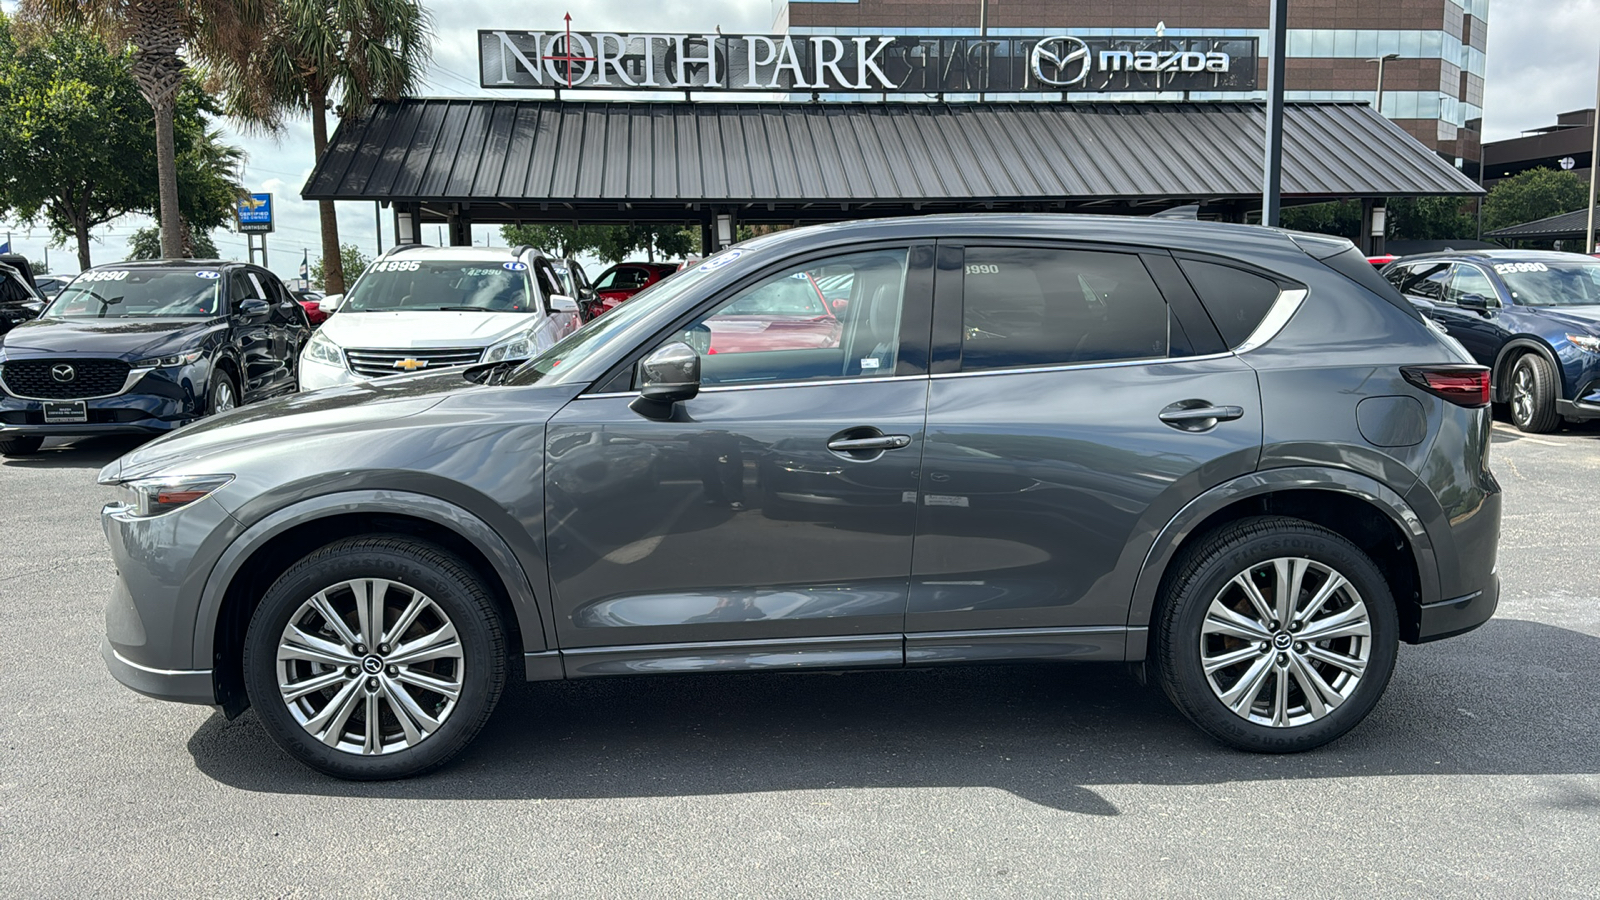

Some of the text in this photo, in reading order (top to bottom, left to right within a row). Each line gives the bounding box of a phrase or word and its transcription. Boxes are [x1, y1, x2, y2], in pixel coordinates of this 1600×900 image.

[492, 31, 722, 87] NORTH
[742, 35, 899, 89] PARK
[369, 260, 422, 274] 14995
[1230, 538, 1326, 565] Firestone
[315, 556, 422, 579] Firestone
